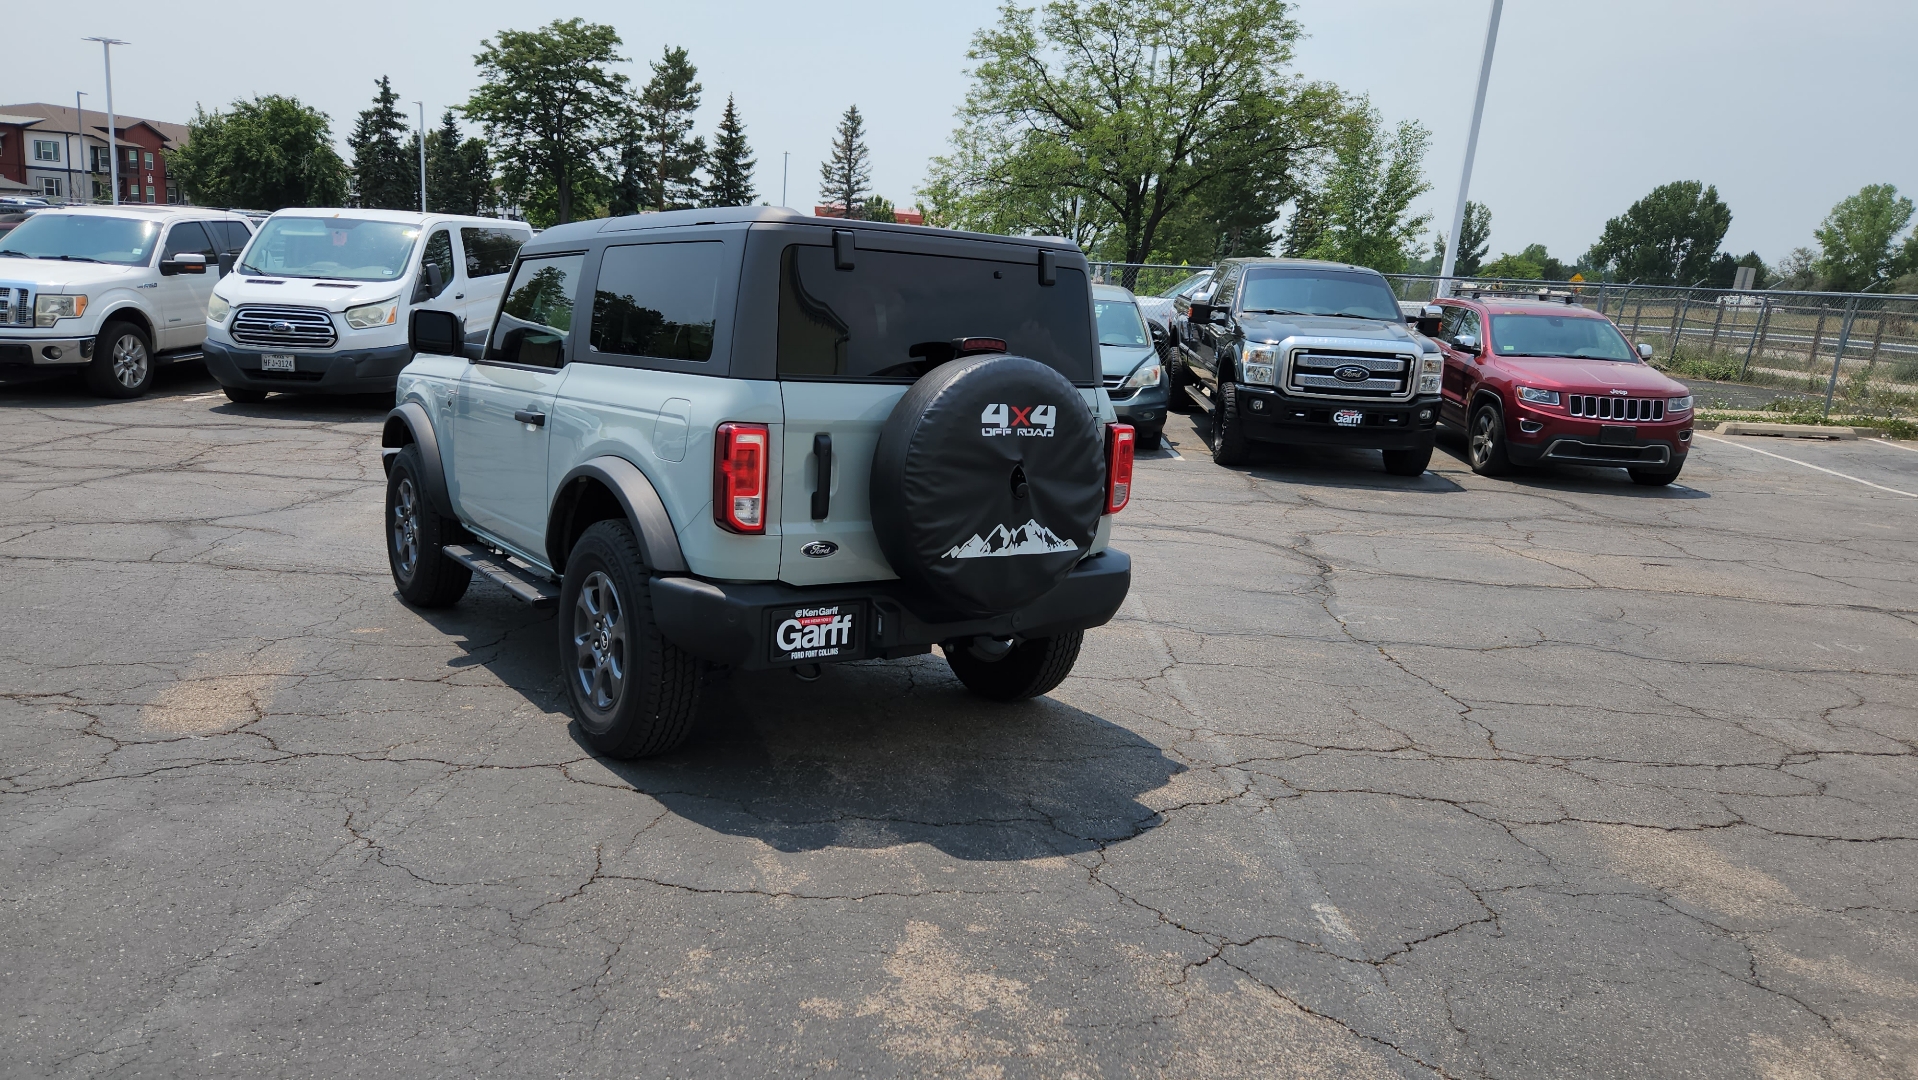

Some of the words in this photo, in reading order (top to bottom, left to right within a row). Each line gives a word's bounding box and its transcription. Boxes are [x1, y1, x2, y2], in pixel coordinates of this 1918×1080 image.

[1333, 411, 1363, 424] Garff
[981, 427, 1012, 437] OFF
[1017, 428, 1055, 438] ROAD
[776, 614, 852, 651] Garff
[791, 651, 805, 660] FORD
[805, 650, 818, 658] FORT
[818, 648, 839, 657] COLLINS
